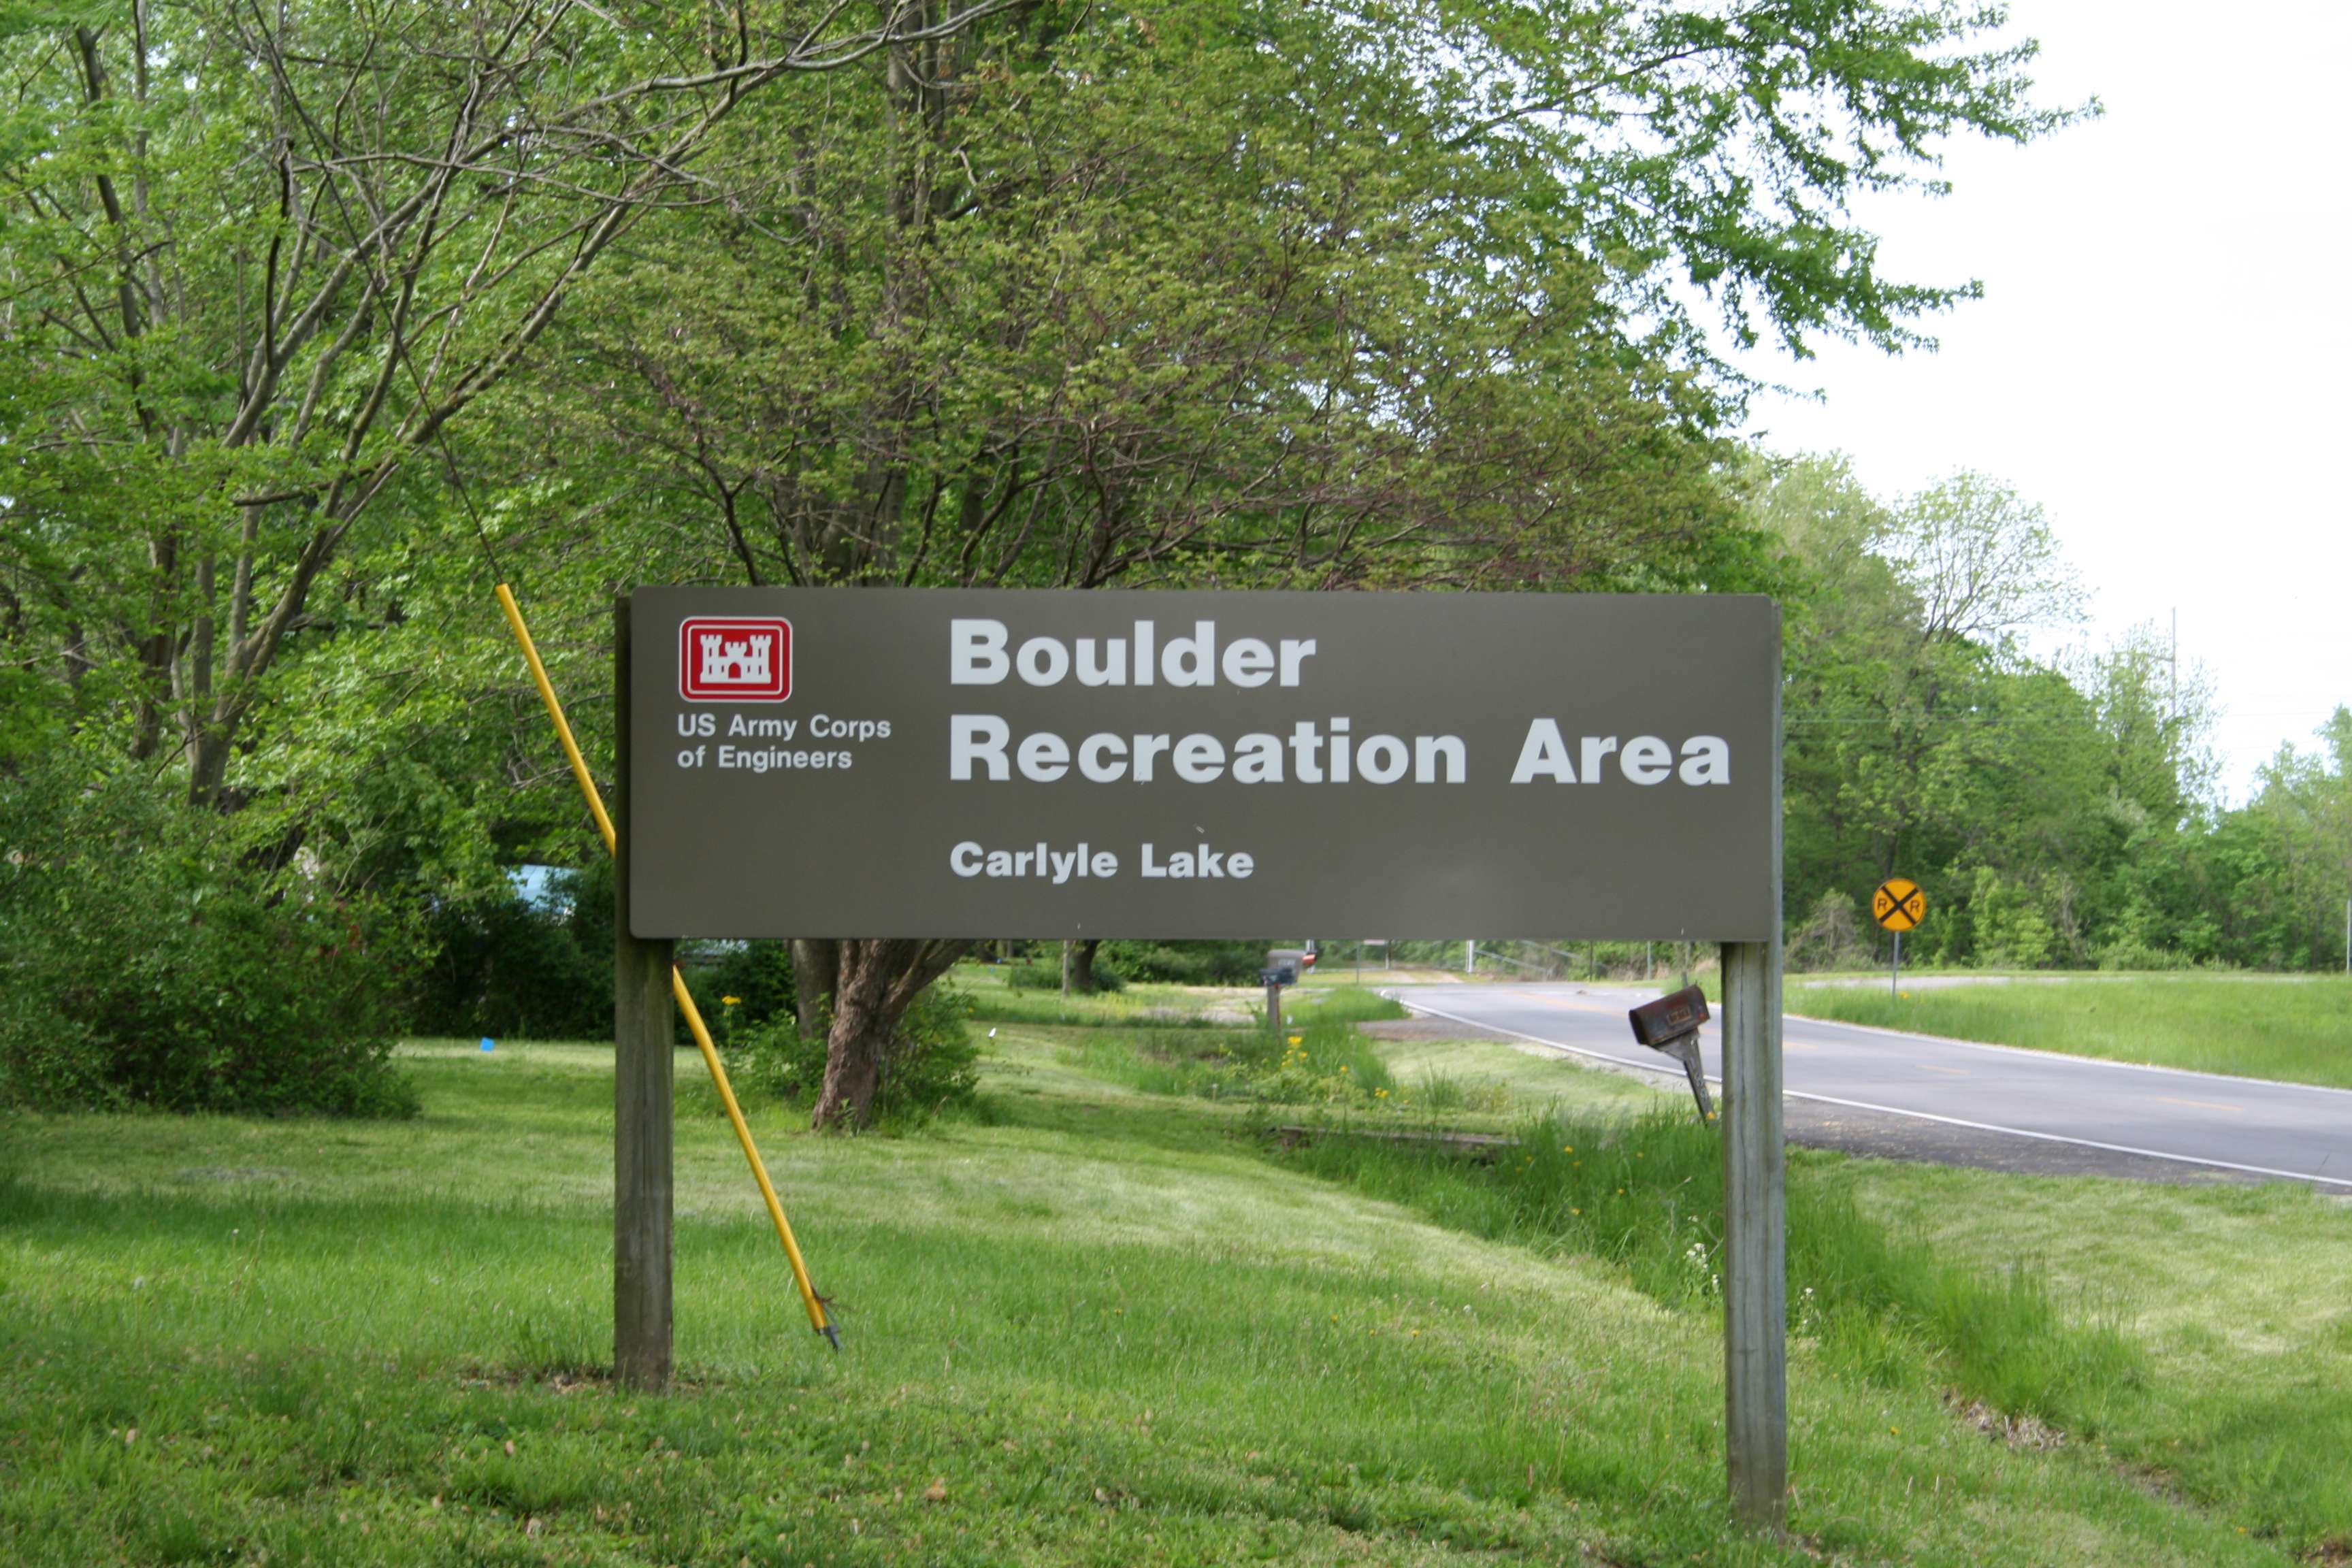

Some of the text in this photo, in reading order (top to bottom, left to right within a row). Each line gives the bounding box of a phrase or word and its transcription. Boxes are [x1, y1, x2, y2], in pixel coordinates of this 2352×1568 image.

[950, 619, 1317, 688] Boulder
[677, 713, 892, 742] US Army Corps
[677, 745, 853, 774] of Engineers
[950, 714, 1730, 786] Recreation Area
[949, 840, 1254, 885] Carlyle Lake
[1877, 898, 1921, 913] R R
